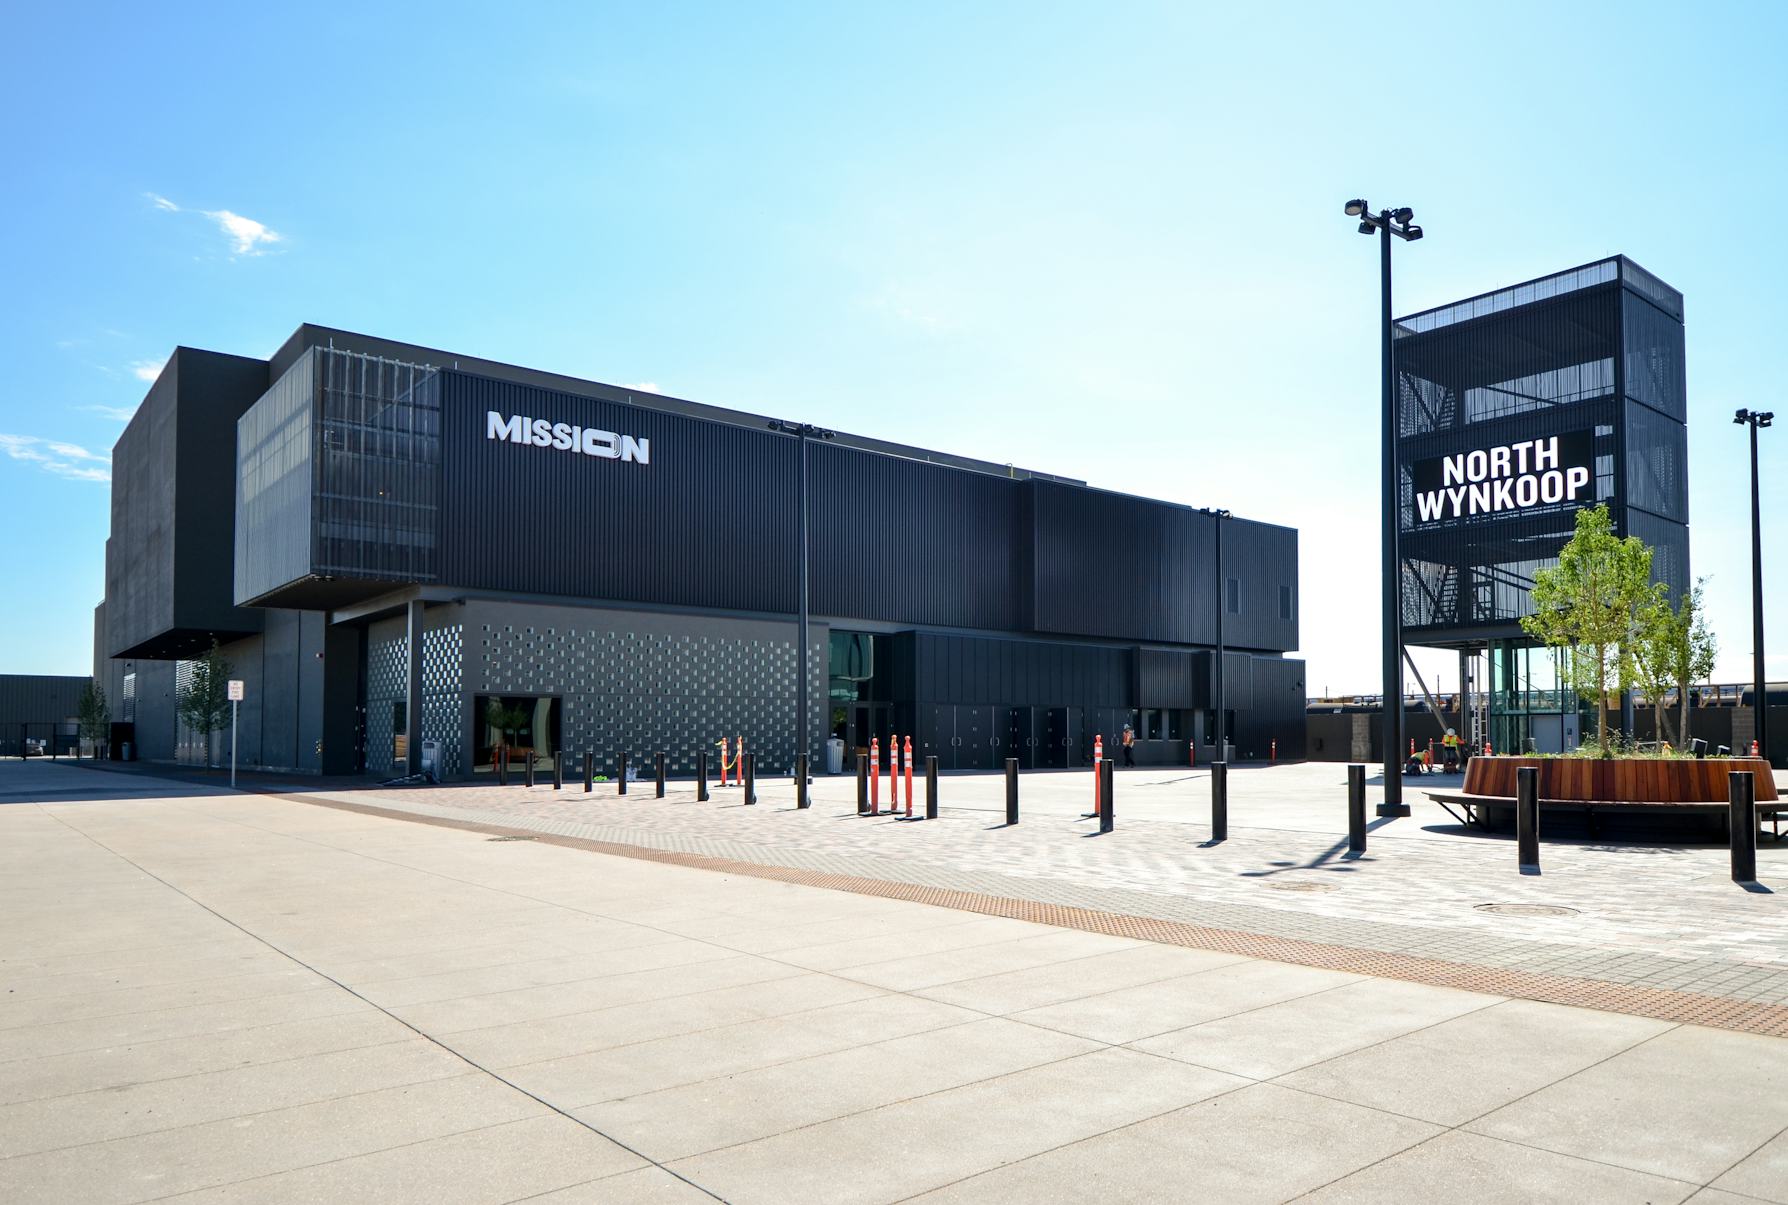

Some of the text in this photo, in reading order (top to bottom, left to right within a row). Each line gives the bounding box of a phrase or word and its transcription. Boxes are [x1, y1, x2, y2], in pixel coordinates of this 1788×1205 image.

[487, 410, 649, 465] MISSION
[1443, 436, 1559, 487] NORTH
[1416, 466, 1589, 522] WYNKOOP
